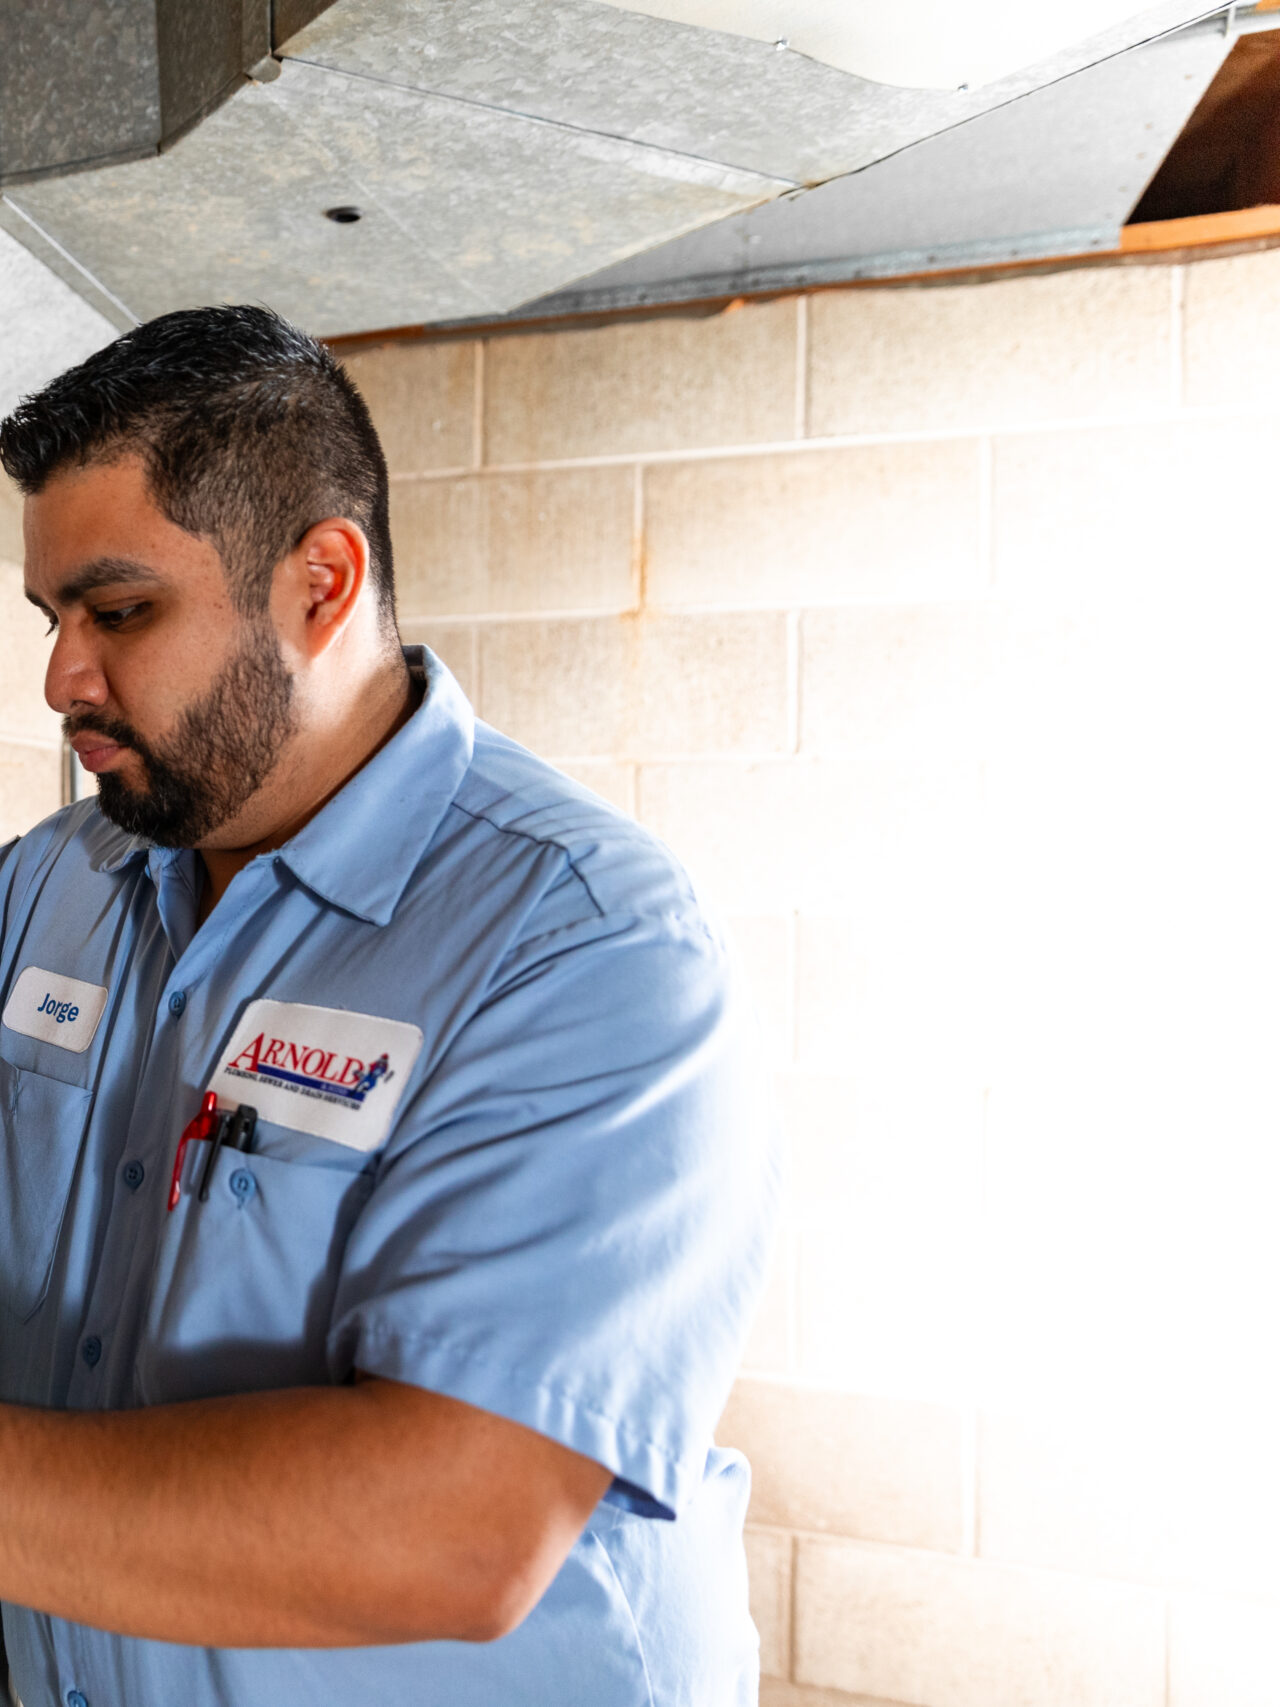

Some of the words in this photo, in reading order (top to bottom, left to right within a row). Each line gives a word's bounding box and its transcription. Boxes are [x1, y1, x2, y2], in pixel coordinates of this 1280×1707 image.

[37, 992, 80, 1023] Jorge
[227, 1032, 365, 1085] ARNOLD
[283, 1082, 300, 1093] AND
